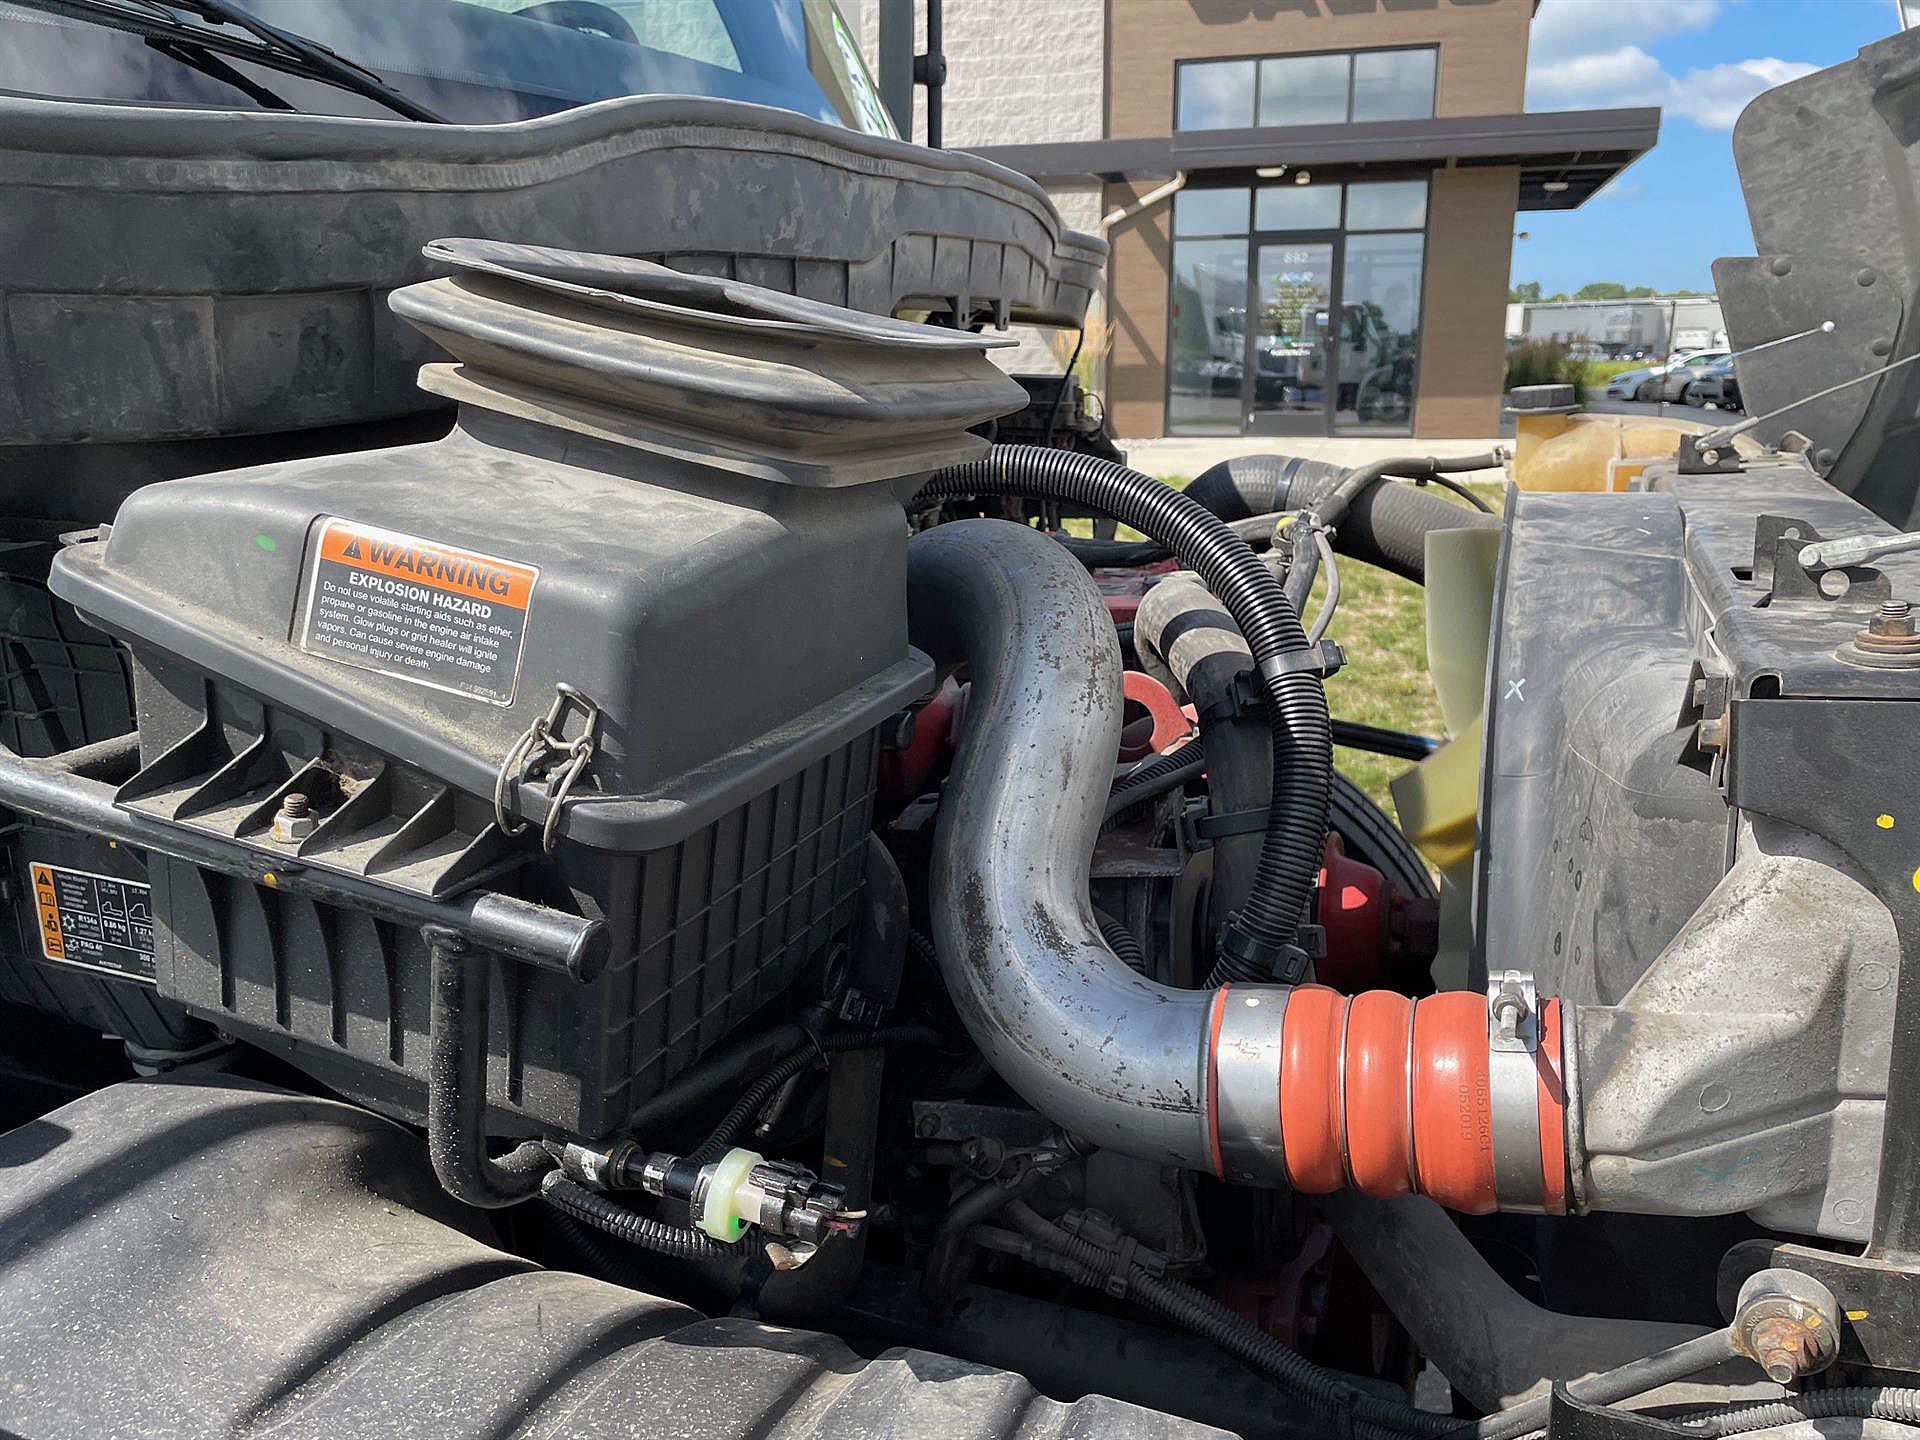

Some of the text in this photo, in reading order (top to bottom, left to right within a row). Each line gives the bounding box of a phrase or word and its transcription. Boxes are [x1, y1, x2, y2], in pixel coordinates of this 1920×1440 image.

[369, 539, 512, 596] WARNING
[324, 581, 512, 639] Do not use volatile starting aids such as ether,
[349, 572, 491, 618] EXPLOSION HAZARD
[318, 620, 491, 673] vapors. Can cause severe engine damage
[320, 608, 497, 660] system. Glow plugs or grid heater will ignite
[321, 596, 499, 648] propane or gasoline in the engine air intake
[314, 631, 430, 670] and personal injury or death.
[1459, 1084, 1473, 1141] 052019
